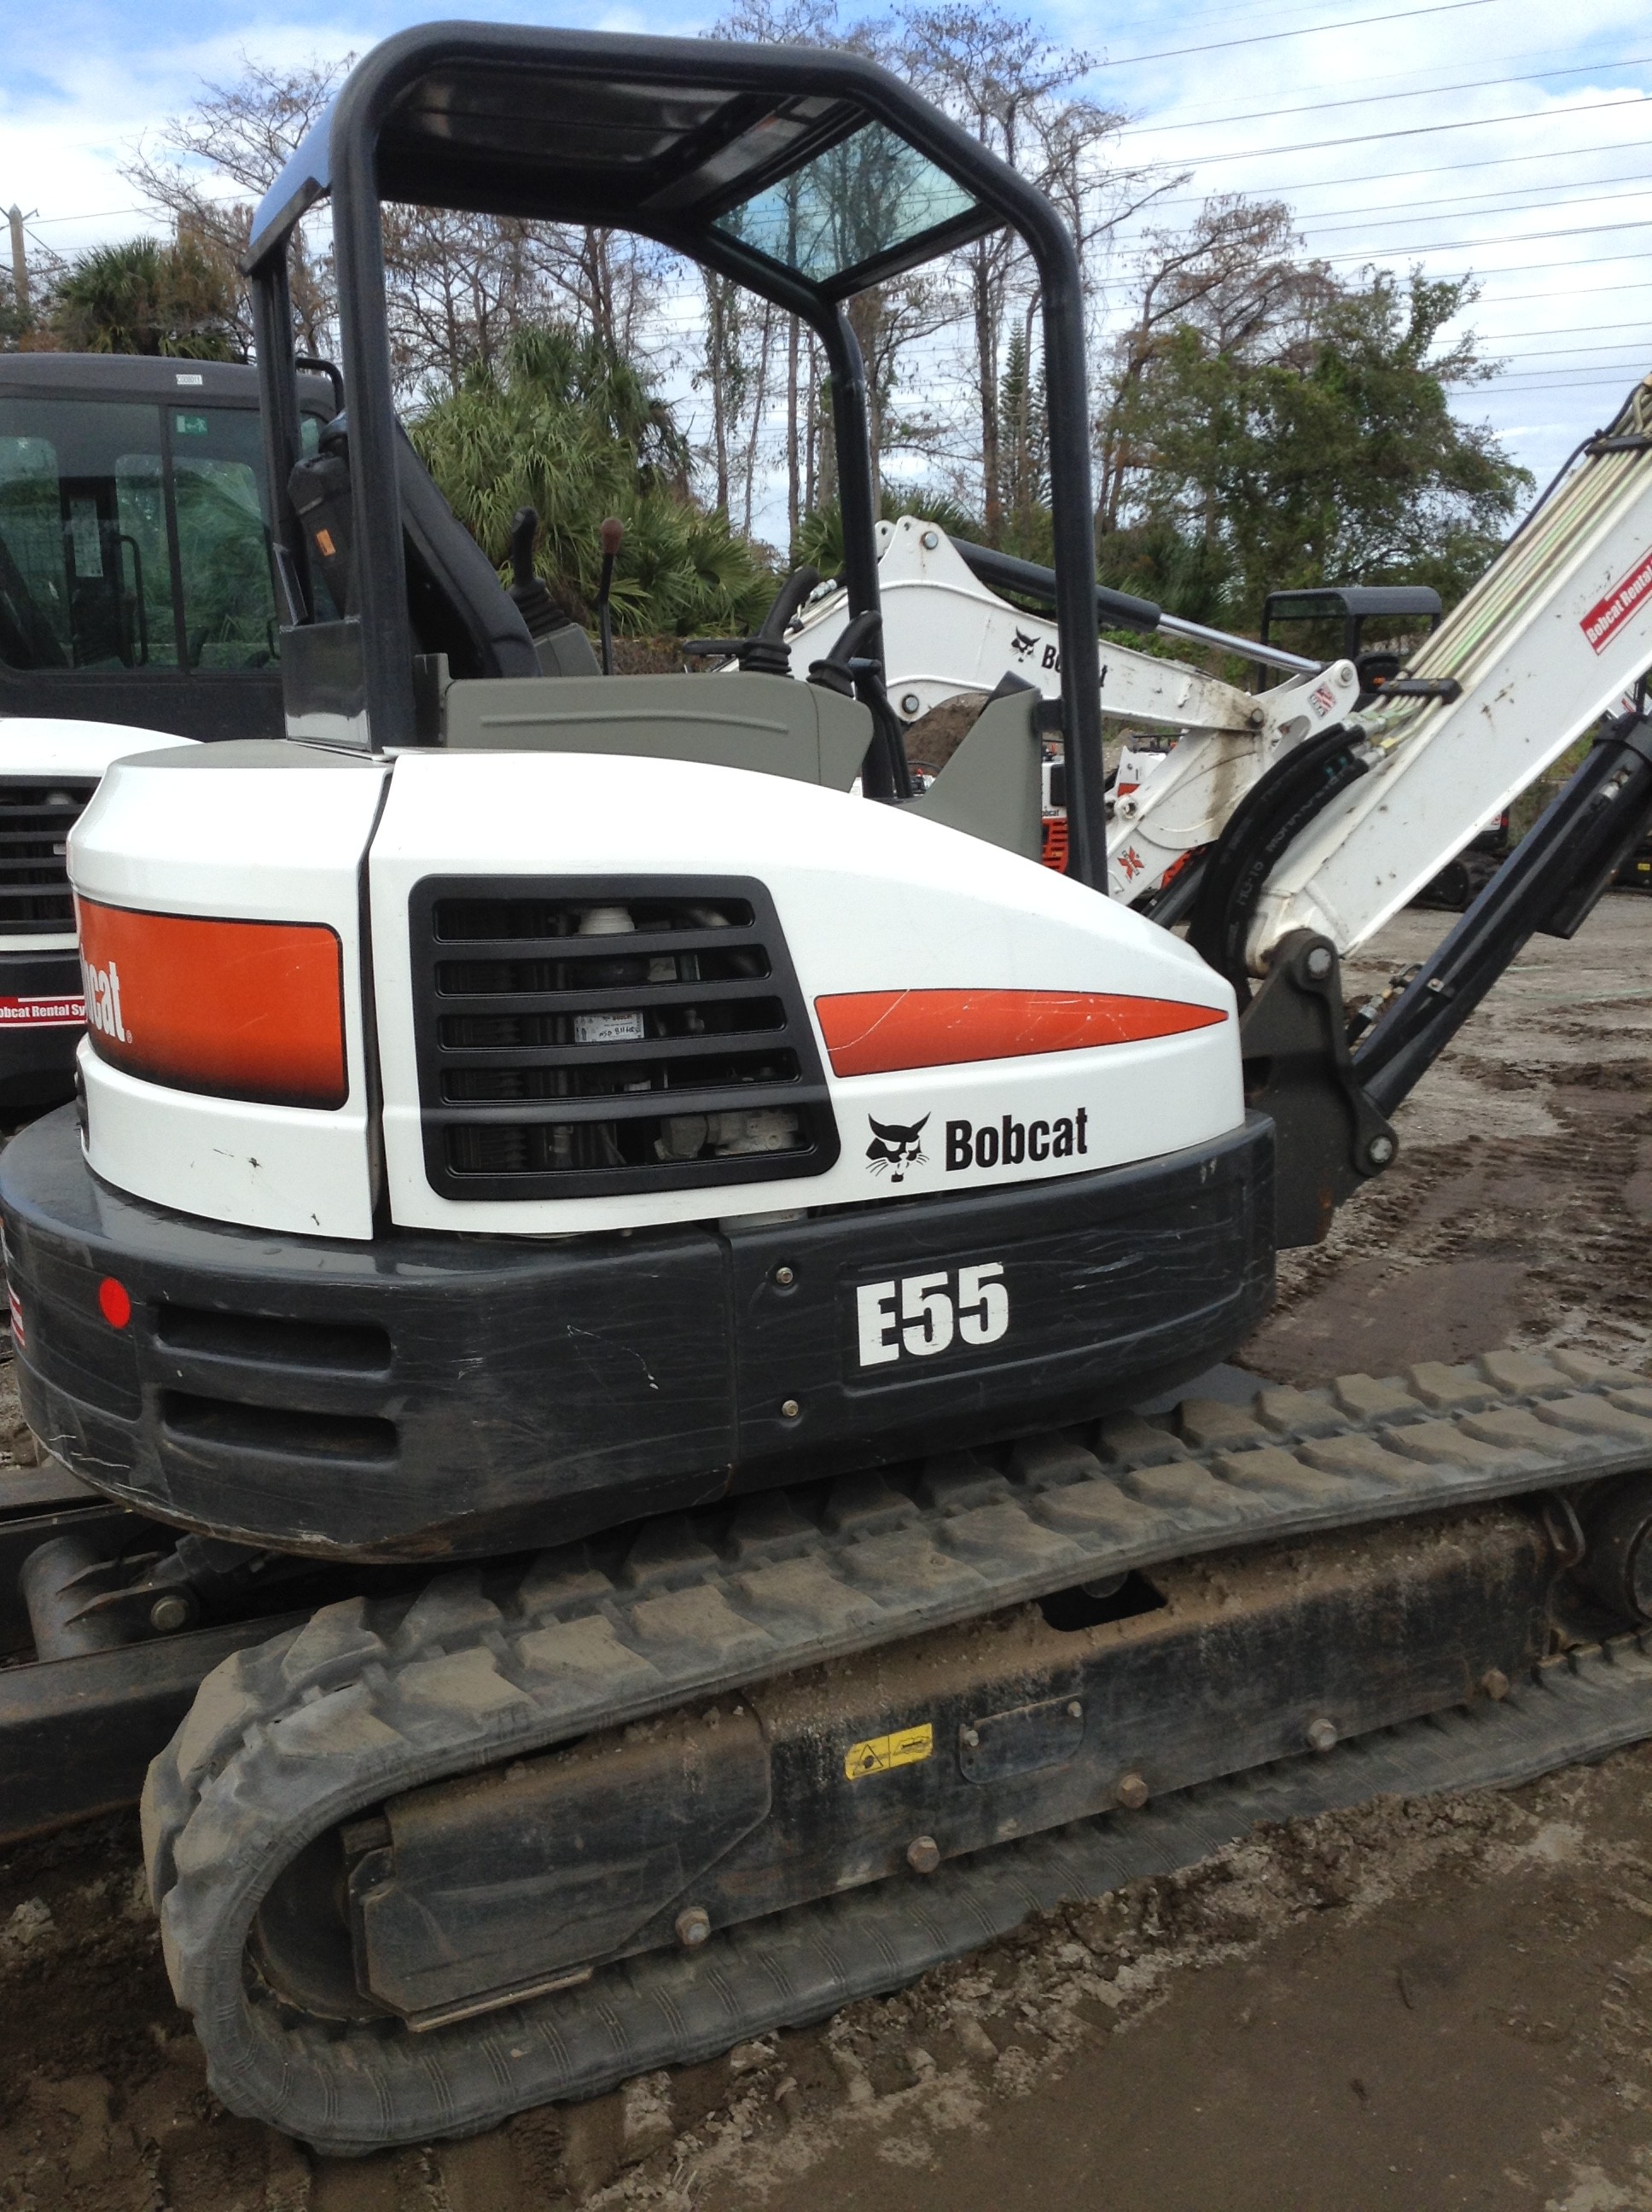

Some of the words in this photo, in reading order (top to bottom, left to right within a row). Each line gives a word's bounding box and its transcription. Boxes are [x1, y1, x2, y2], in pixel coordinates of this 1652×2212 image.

[1585, 599, 1625, 643] Bobcat
[32, 1004, 70, 1017] Rental
[945, 1107, 1088, 1172] Bobcat
[857, 1262, 1009, 1366] E55
